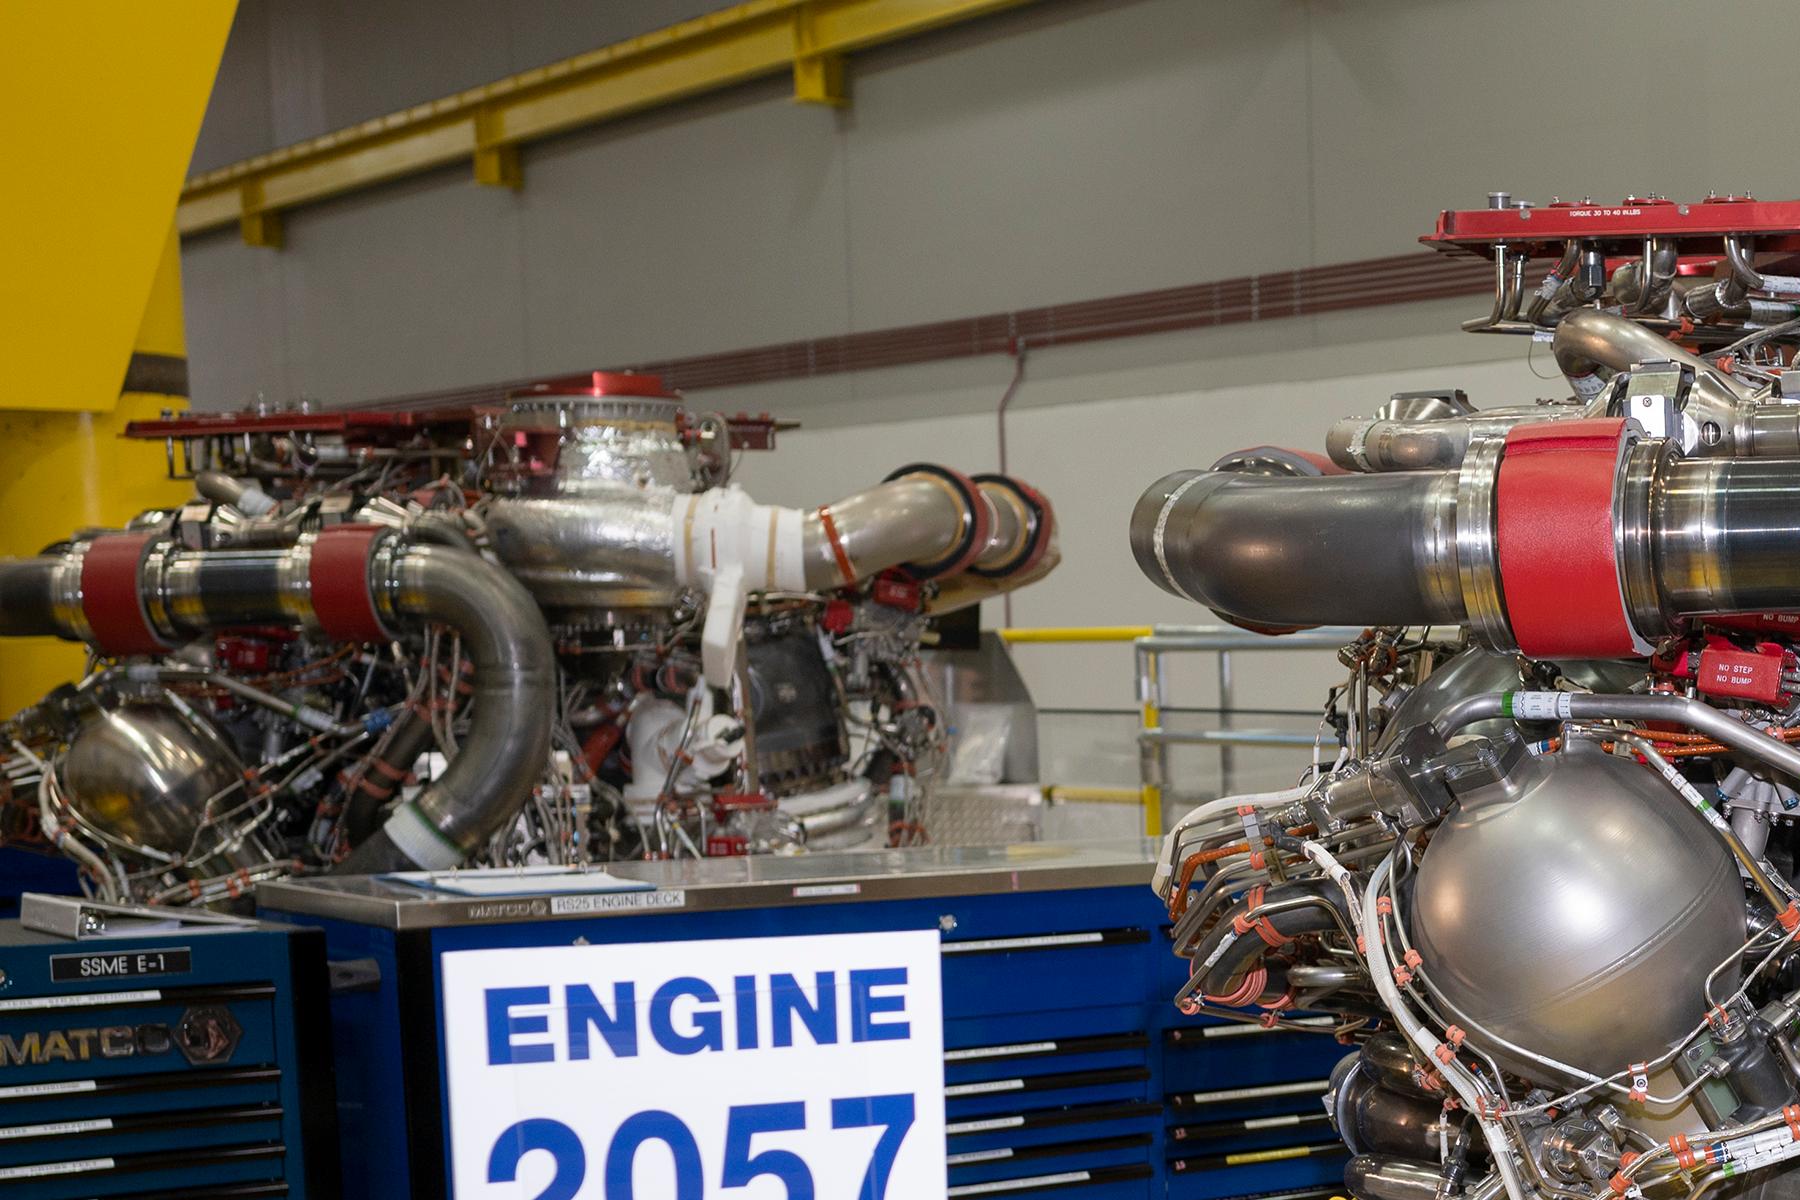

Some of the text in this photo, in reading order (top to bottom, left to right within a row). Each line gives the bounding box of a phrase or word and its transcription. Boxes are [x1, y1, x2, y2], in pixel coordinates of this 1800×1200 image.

[1762, 613, 1799, 624] NO BUMP
[1718, 663, 1753, 674] NO STEP
[1716, 674, 1752, 685] NO BUMP
[557, 892, 680, 912] RS25 ENGINE DECK
[80, 954, 165, 977] SSME E-1
[484, 967, 911, 1066] ENGINE
